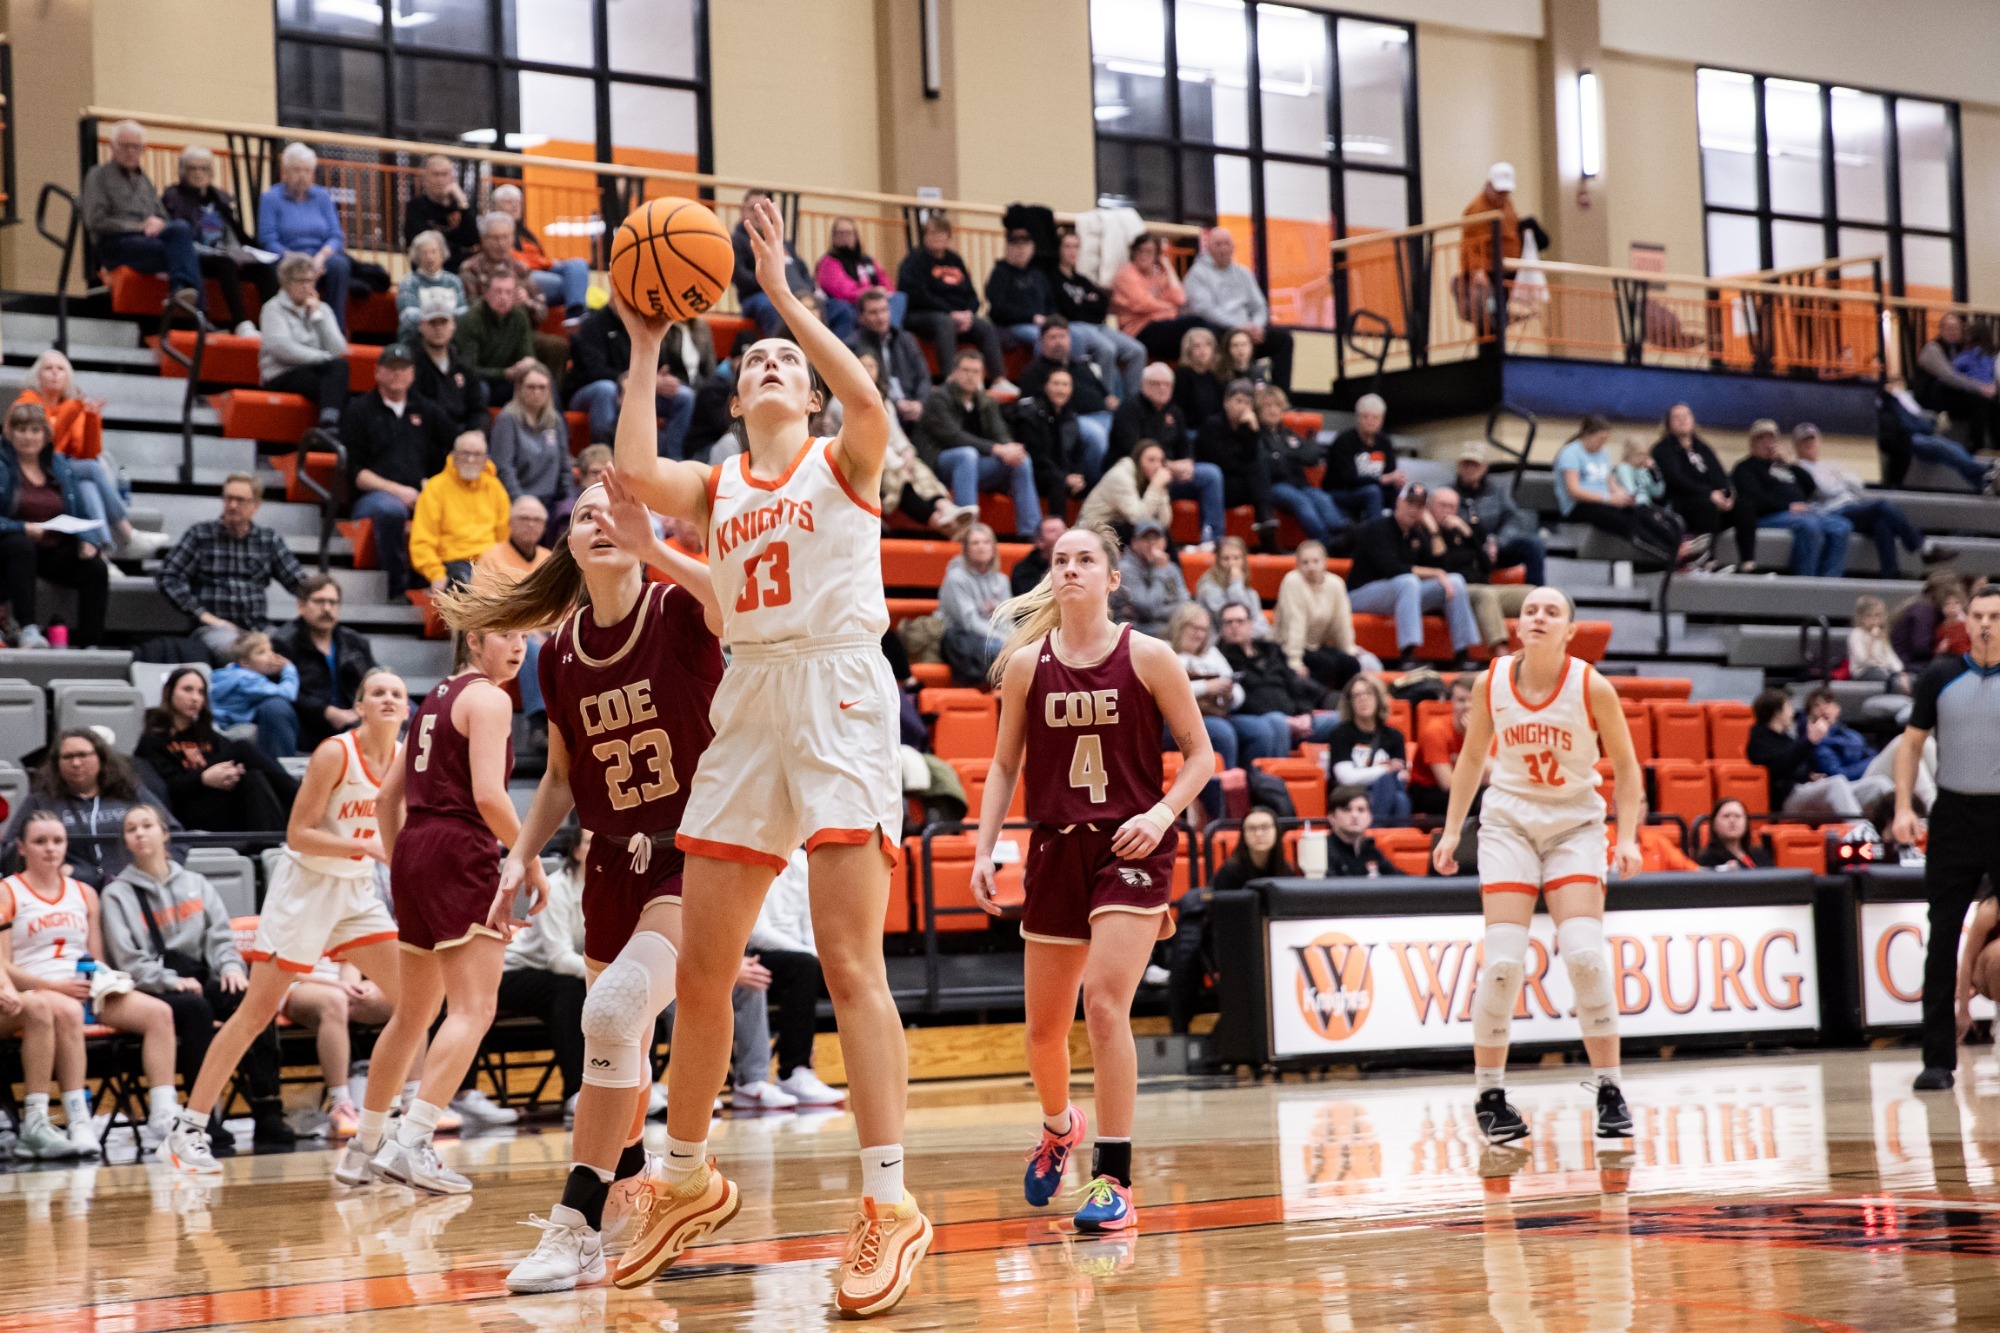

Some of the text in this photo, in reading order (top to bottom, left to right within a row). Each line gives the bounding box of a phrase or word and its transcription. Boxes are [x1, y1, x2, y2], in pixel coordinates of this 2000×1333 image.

[716, 497, 815, 562] KNIGHTS
[579, 678, 658, 737] COE
[1045, 688, 1119, 728] COE
[414, 713, 438, 773] 5
[592, 728, 680, 811] 23
[1068, 734, 1109, 804] 4
[338, 799, 378, 819] KNIG
[1388, 930, 1804, 1026] WRBURG
